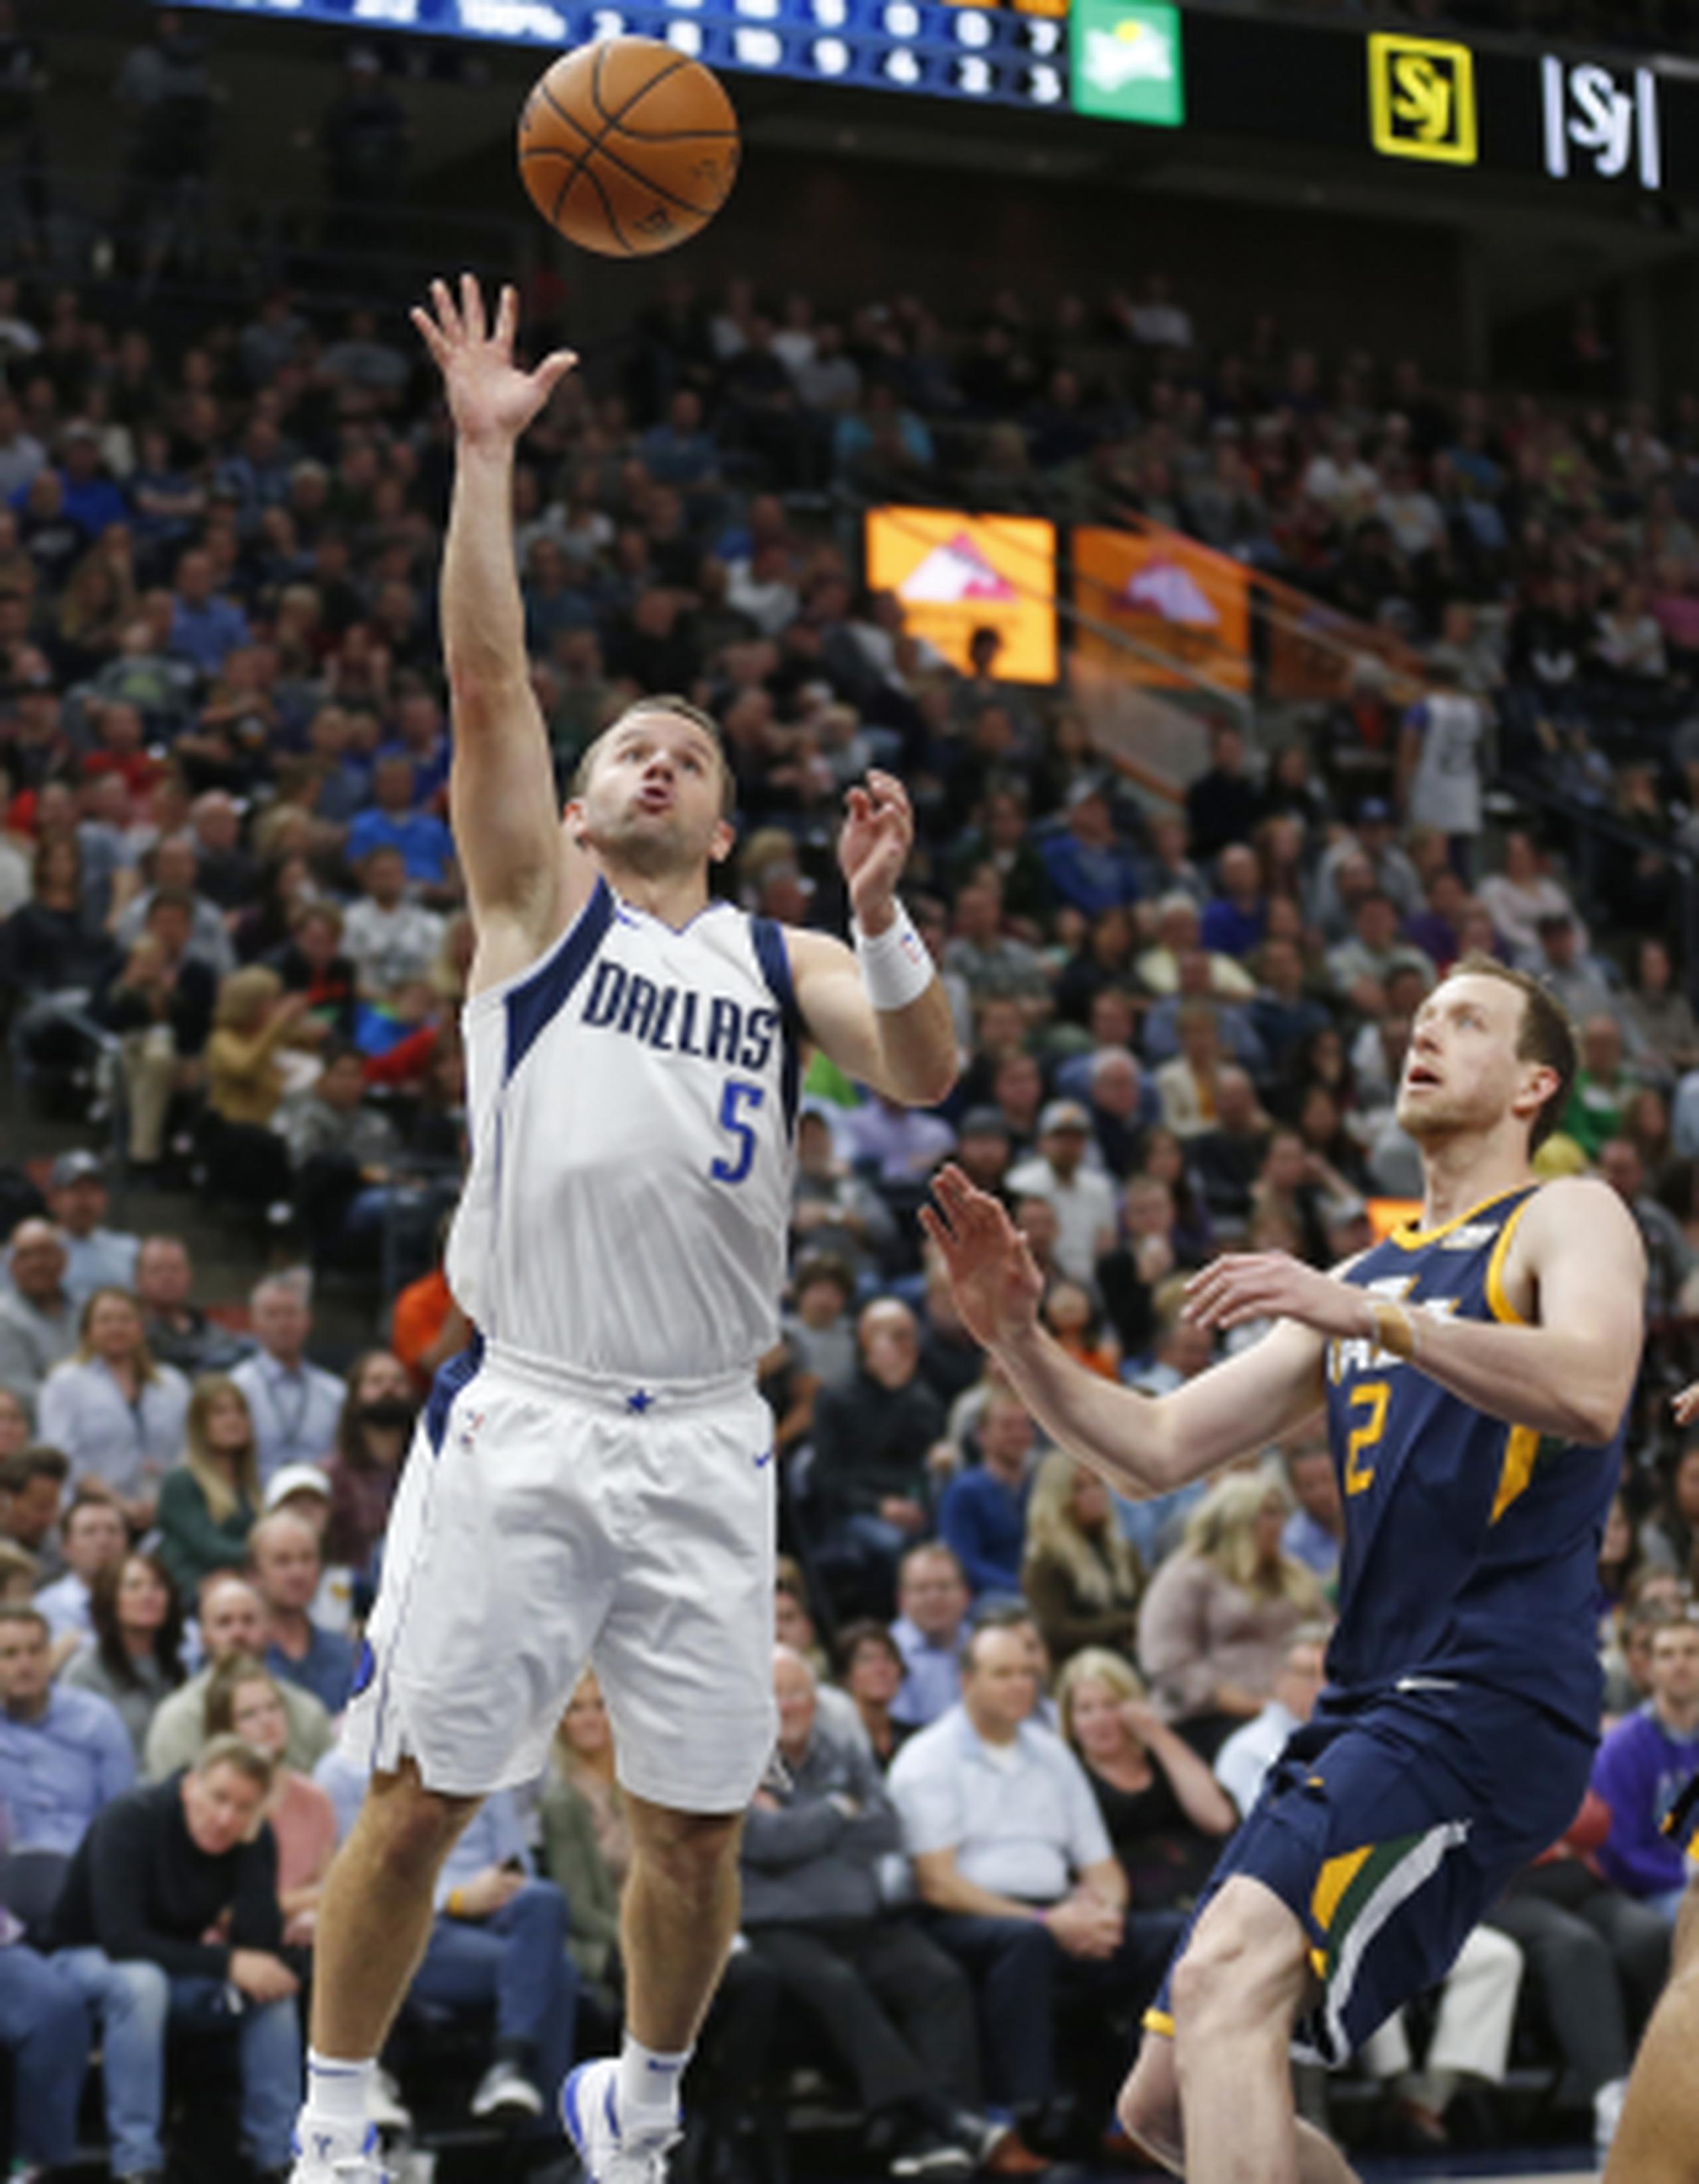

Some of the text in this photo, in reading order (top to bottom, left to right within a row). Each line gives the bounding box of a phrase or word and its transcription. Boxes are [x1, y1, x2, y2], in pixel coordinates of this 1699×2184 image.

[581, 960, 779, 1070] DALLAS
[711, 1079, 764, 1184] 5
[1346, 1381, 1391, 1495] 2
